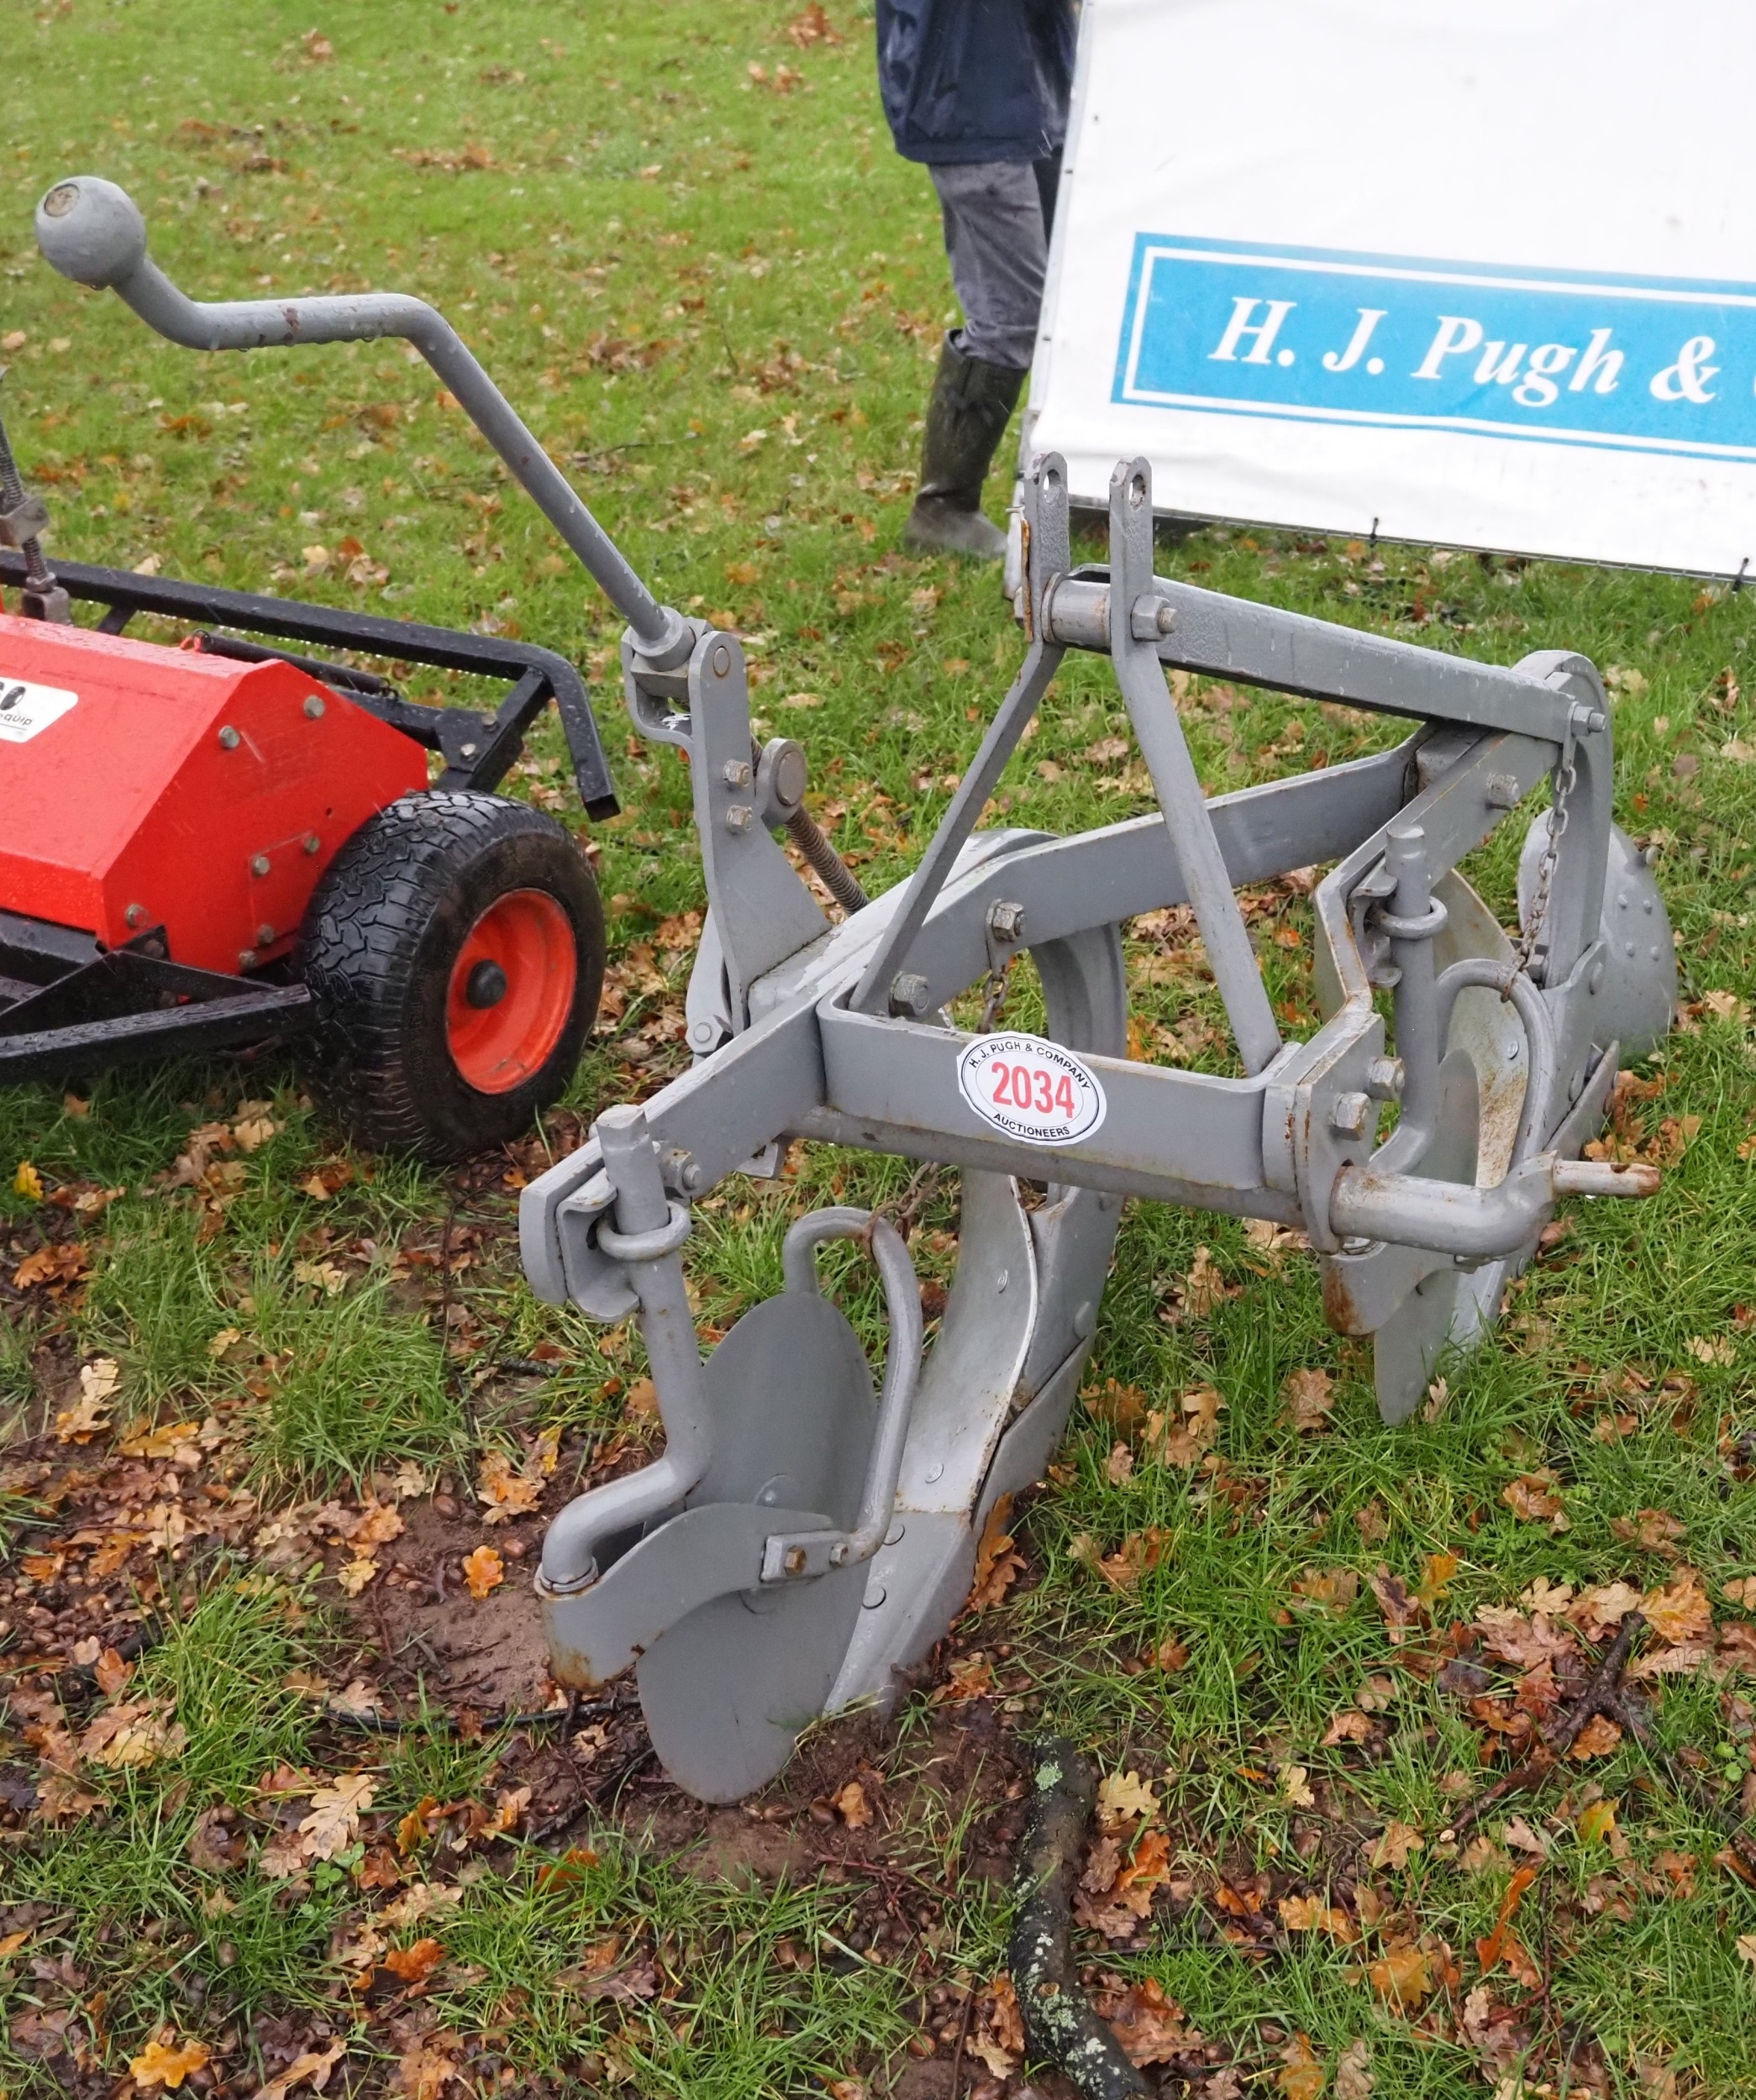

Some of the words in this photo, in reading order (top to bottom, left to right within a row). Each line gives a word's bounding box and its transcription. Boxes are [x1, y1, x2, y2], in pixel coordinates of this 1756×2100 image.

[1207, 297, 1296, 367] H.
[1322, 308, 1388, 375] J.
[1411, 316, 1625, 407] Pugh
[1649, 336, 1721, 403] &
[969, 1058, 981, 1068] H.
[981, 1049, 990, 1058] J.
[990, 1042, 1021, 1053] PUGH
[1025, 1043, 1033, 1052] &
[1037, 1047, 1091, 1089] COMPANY
[991, 1062, 1075, 1118] 2034
[993, 1113, 1070, 1137] AUCTIONEERS
